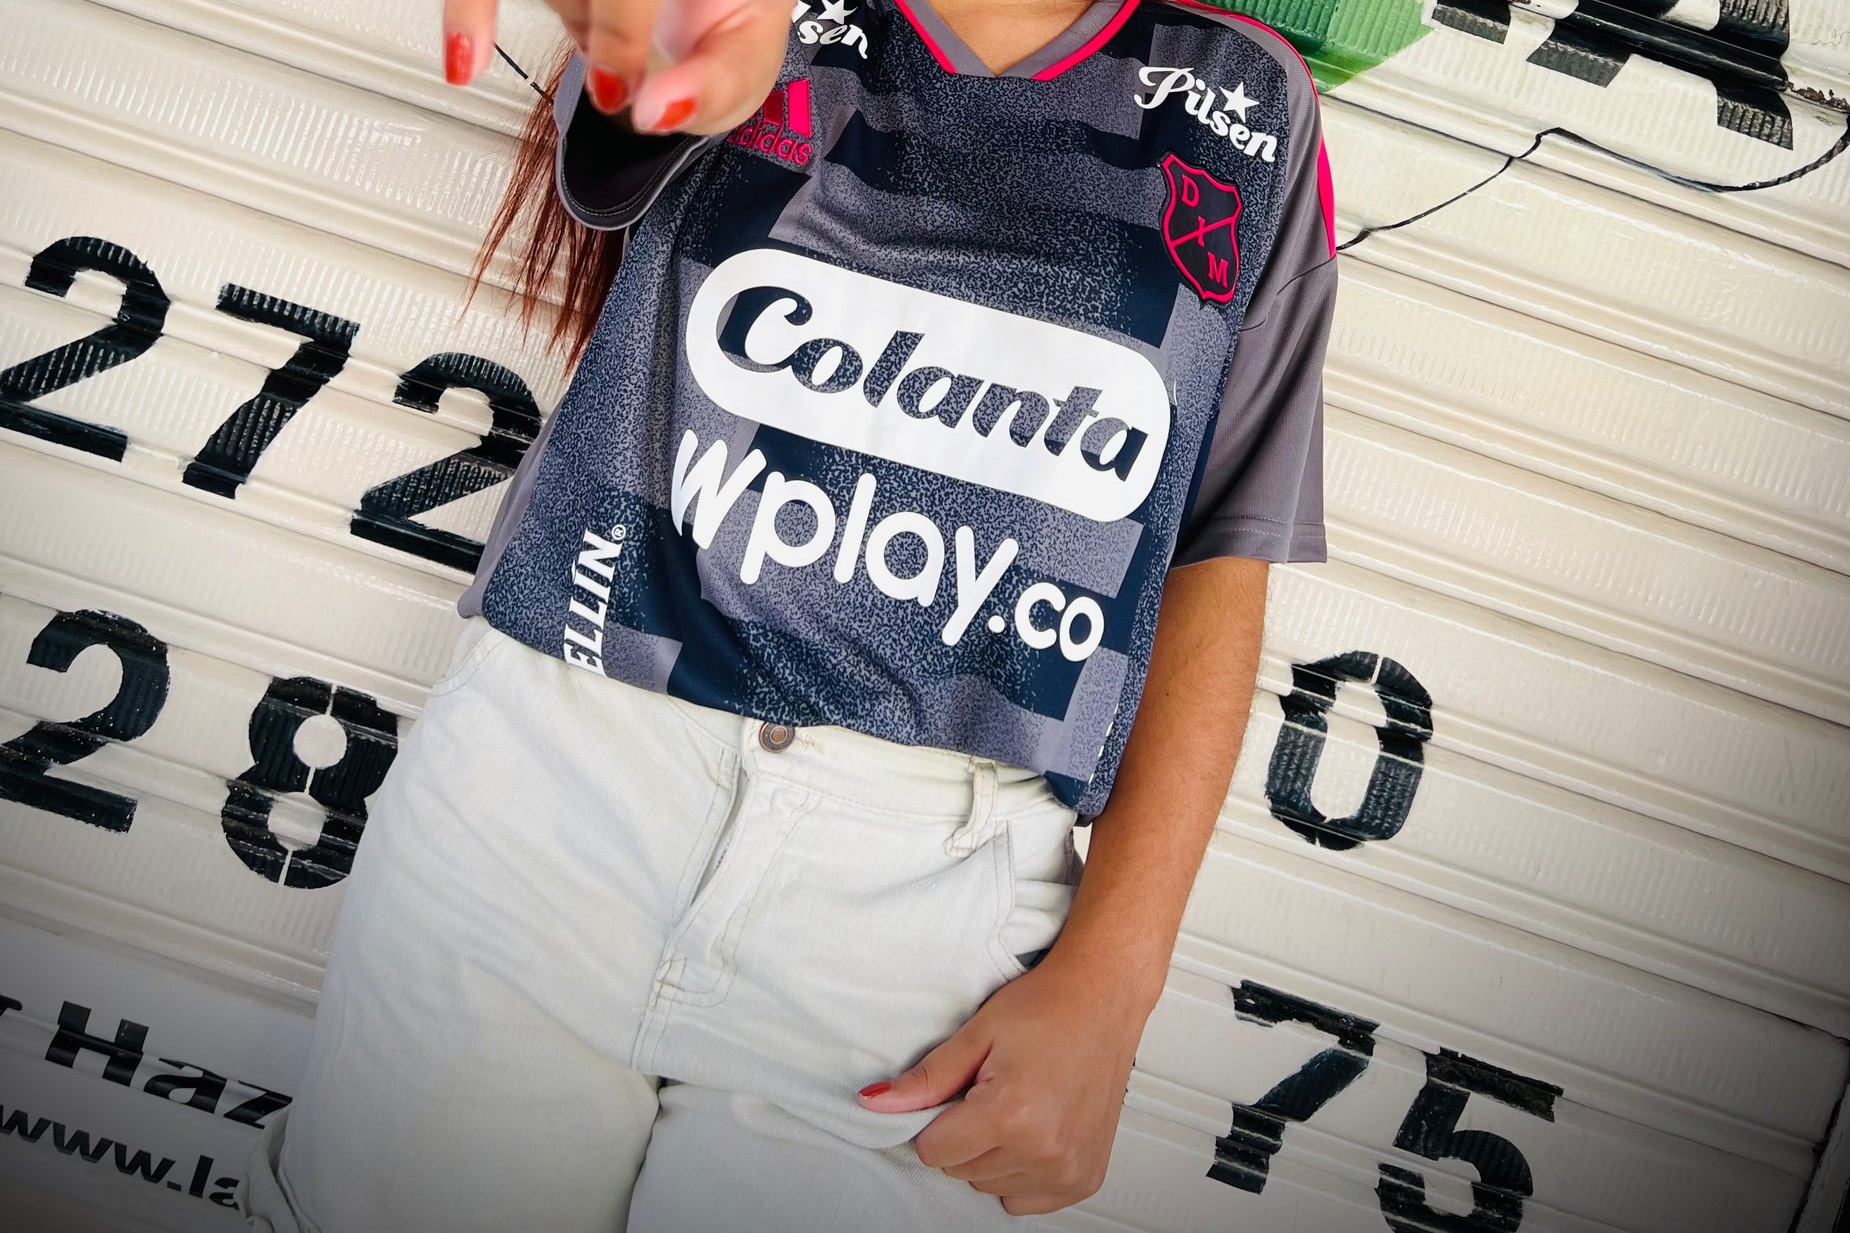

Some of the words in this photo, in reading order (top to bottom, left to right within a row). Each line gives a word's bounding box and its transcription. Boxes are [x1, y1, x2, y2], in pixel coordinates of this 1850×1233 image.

[1133, 66, 1278, 163] Pilsen
[715, 285, 1149, 482] Colanta
[670, 428, 1105, 662] Wplay.co
